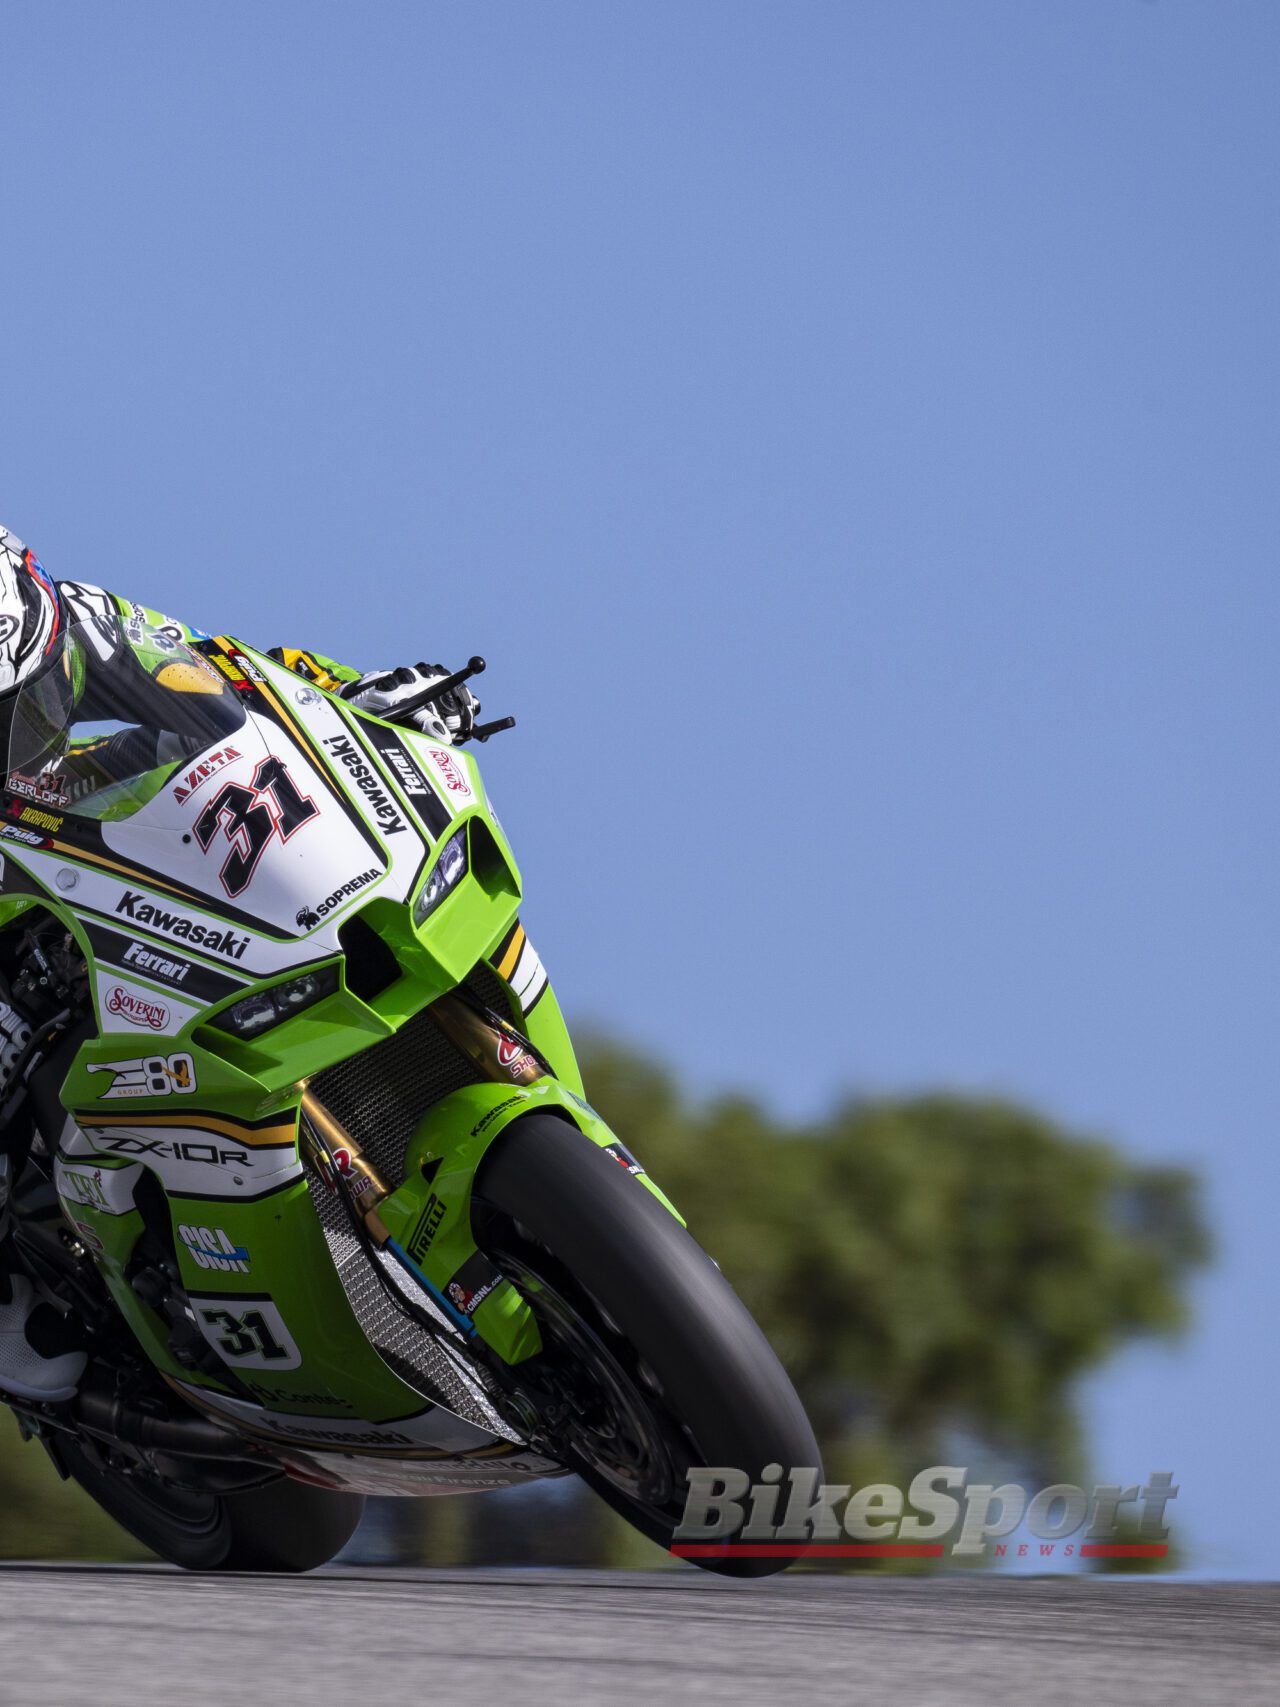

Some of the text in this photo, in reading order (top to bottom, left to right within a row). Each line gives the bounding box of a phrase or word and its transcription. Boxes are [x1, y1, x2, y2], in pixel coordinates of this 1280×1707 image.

[173, 747, 241, 804] AZETA
[322, 735, 407, 835] Kawasaki
[380, 748, 427, 794] Ferrari
[1, 825, 44, 845] Puig
[192, 755, 320, 898] 31
[316, 868, 383, 916] SOPREMA
[114, 891, 251, 960] Kawasaki
[123, 942, 191, 981] Ferrari
[109, 988, 165, 1027] SOVERINI
[511, 1055, 538, 1078] SHO
[99, 1137, 254, 1167] ZX-10R
[178, 1225, 250, 1273] CISA
[406, 1193, 447, 1267] PIRELLI
[202, 1310, 288, 1360] 31
